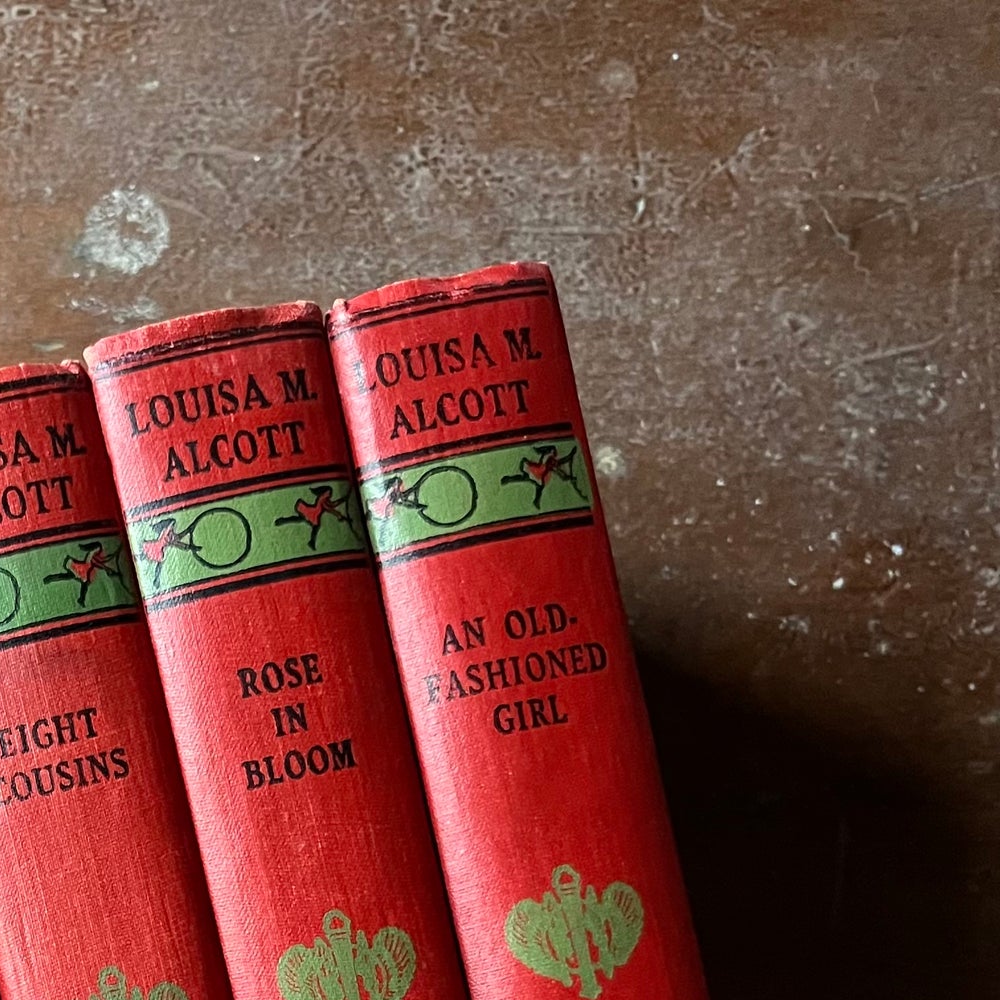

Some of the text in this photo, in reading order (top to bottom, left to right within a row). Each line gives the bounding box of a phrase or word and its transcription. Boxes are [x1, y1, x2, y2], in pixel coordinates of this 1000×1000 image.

[353, 327, 542, 394] LOUISA M.
[125, 368, 319, 437] LOUISA M.
[390, 380, 529, 440] ALCOTT
[45, 422, 88, 458] M.
[164, 420, 306, 482] ALCOTT
[443, 603, 578, 656] AN OLD-
[237, 653, 323, 698] ROSE
[423, 642, 608, 706] FASHIONED
[270, 703, 308, 737] IN
[493, 694, 568, 735] GIRL
[241, 739, 358, 790] BLOOM
